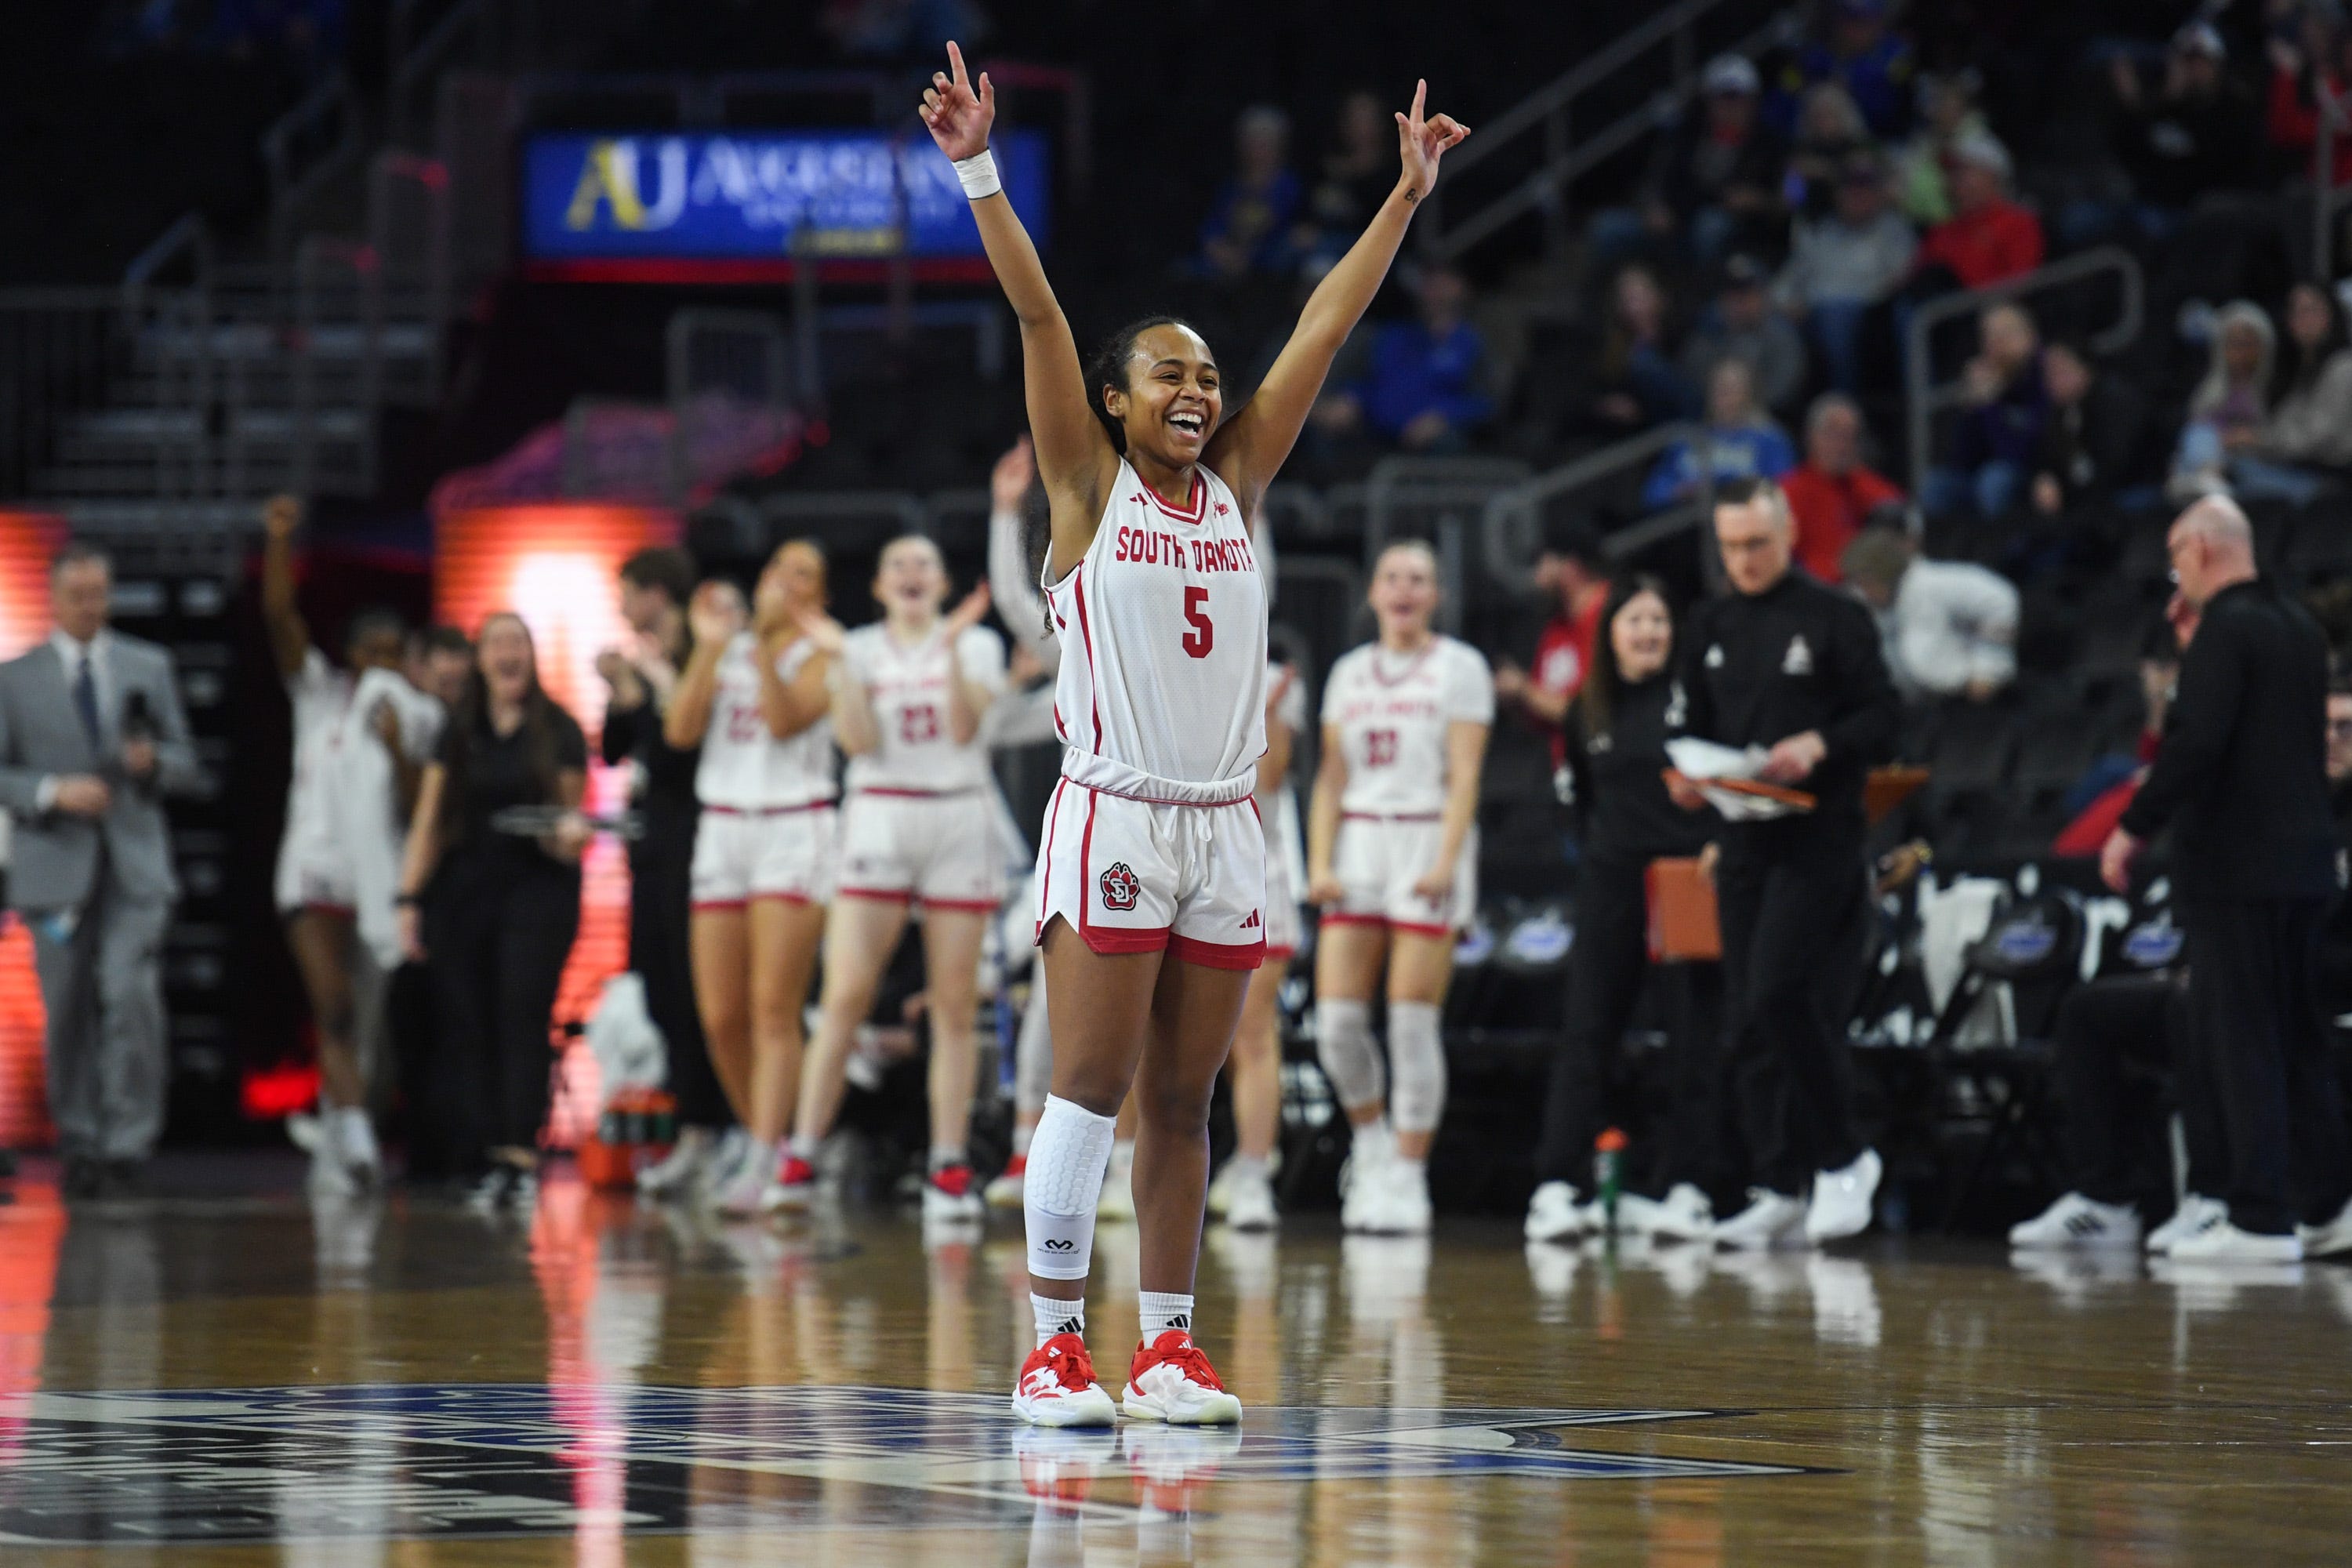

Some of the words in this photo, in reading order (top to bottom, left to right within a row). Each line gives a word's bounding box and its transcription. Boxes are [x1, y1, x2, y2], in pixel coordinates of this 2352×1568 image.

[568, 135, 688, 230] AU
[1116, 525, 1187, 569] SOUTH
[1190, 537, 1255, 573] DAKOTA
[1182, 586, 1213, 659] 5
